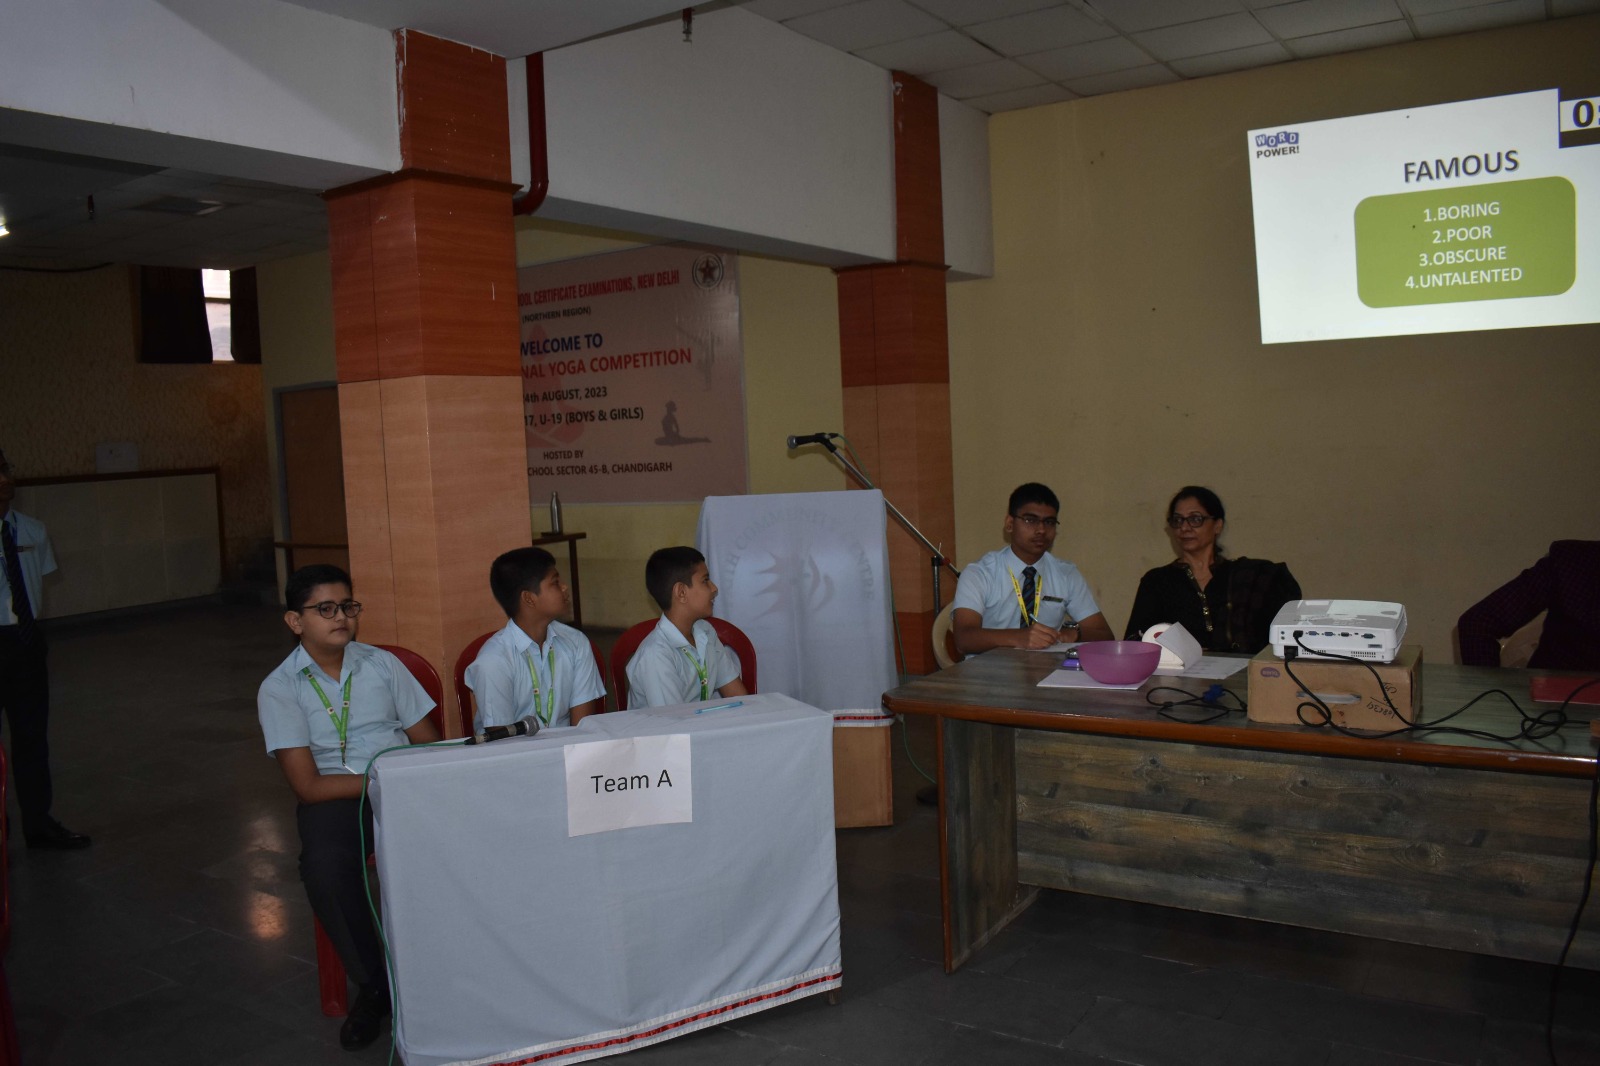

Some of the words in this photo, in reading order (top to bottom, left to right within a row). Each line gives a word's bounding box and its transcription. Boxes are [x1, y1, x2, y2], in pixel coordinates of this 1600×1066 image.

[1256, 132, 1298, 147] WORD
[1257, 146, 1299, 158] POWER!
[1404, 150, 1519, 183] FAMOUS
[1423, 202, 1499, 222] 1.BORING
[1432, 226, 1492, 244] 2.POOR
[1419, 246, 1507, 267] 3.OBSCURE
[534, 285, 577, 305] CERTIFICATE
[579, 277, 636, 298] EXAMINATIONS,
[637, 274, 655, 290] NEW
[657, 269, 680, 286] DELHI
[1405, 267, 1522, 288] 4.UNTALENTED
[522, 310, 561, 324] (NORTHERN
[563, 306, 591, 318] REGION)
[520, 335, 581, 357] WELCOME
[585, 332, 603, 350] TO
[549, 358, 586, 377] YOGA
[590, 348, 692, 373] COMPETITION
[523, 388, 540, 403] 4th
[541, 387, 582, 402] AUGUST,
[584, 386, 608, 399] 2023
[540, 411, 562, 426] U-19
[565, 409, 596, 426] (BOYS
[598, 408, 607, 422] &
[610, 406, 644, 421] GIRLS)
[543, 450, 573, 461] HOSTED
[574, 449, 584, 460] BY
[556, 464, 587, 476] SECTOR
[588, 464, 610, 476] 45-B,
[611, 461, 673, 474] CHANDIGARH
[591, 774, 649, 794] Team
[657, 769, 672, 787] A
